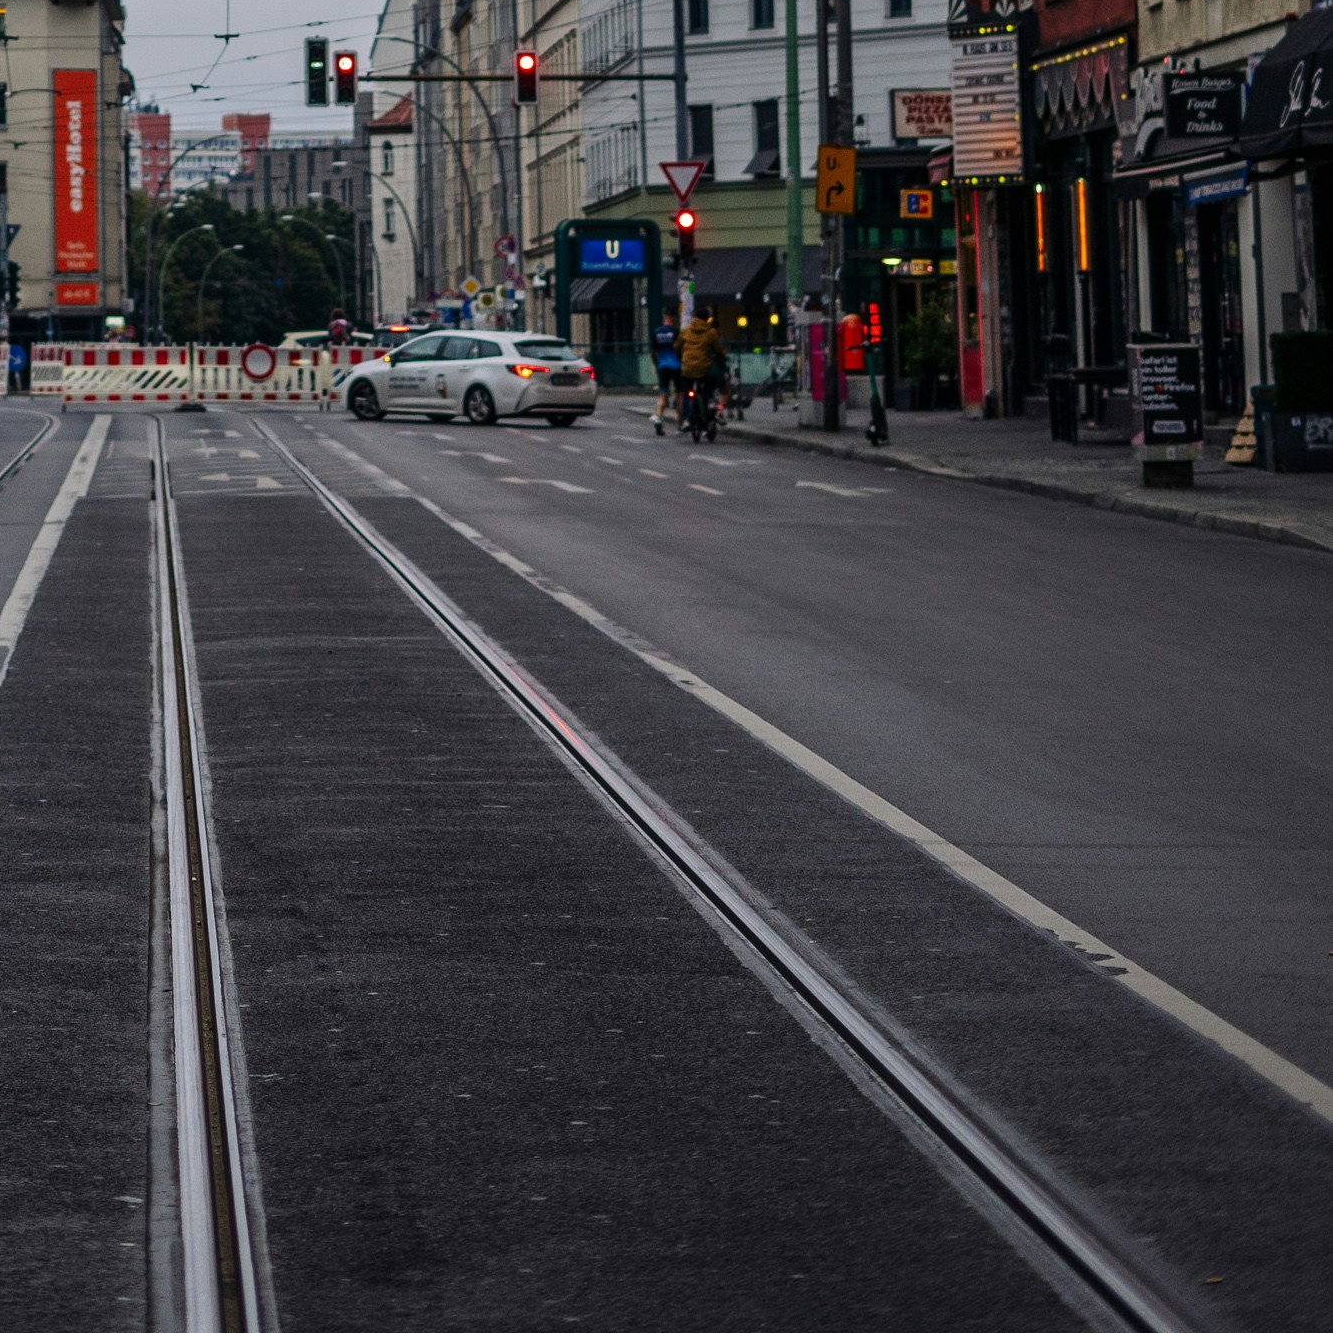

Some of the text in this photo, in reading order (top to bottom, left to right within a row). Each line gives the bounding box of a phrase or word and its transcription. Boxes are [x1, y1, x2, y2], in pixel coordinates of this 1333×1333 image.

[908, 105, 951, 114] PIZZA
[1186, 97, 1218, 110] Food
[906, 115, 952, 124] PASTA
[1186, 121, 1224, 134] Drinks
[66, 100, 86, 213] easyHotel
[605, 239, 620, 260] U
